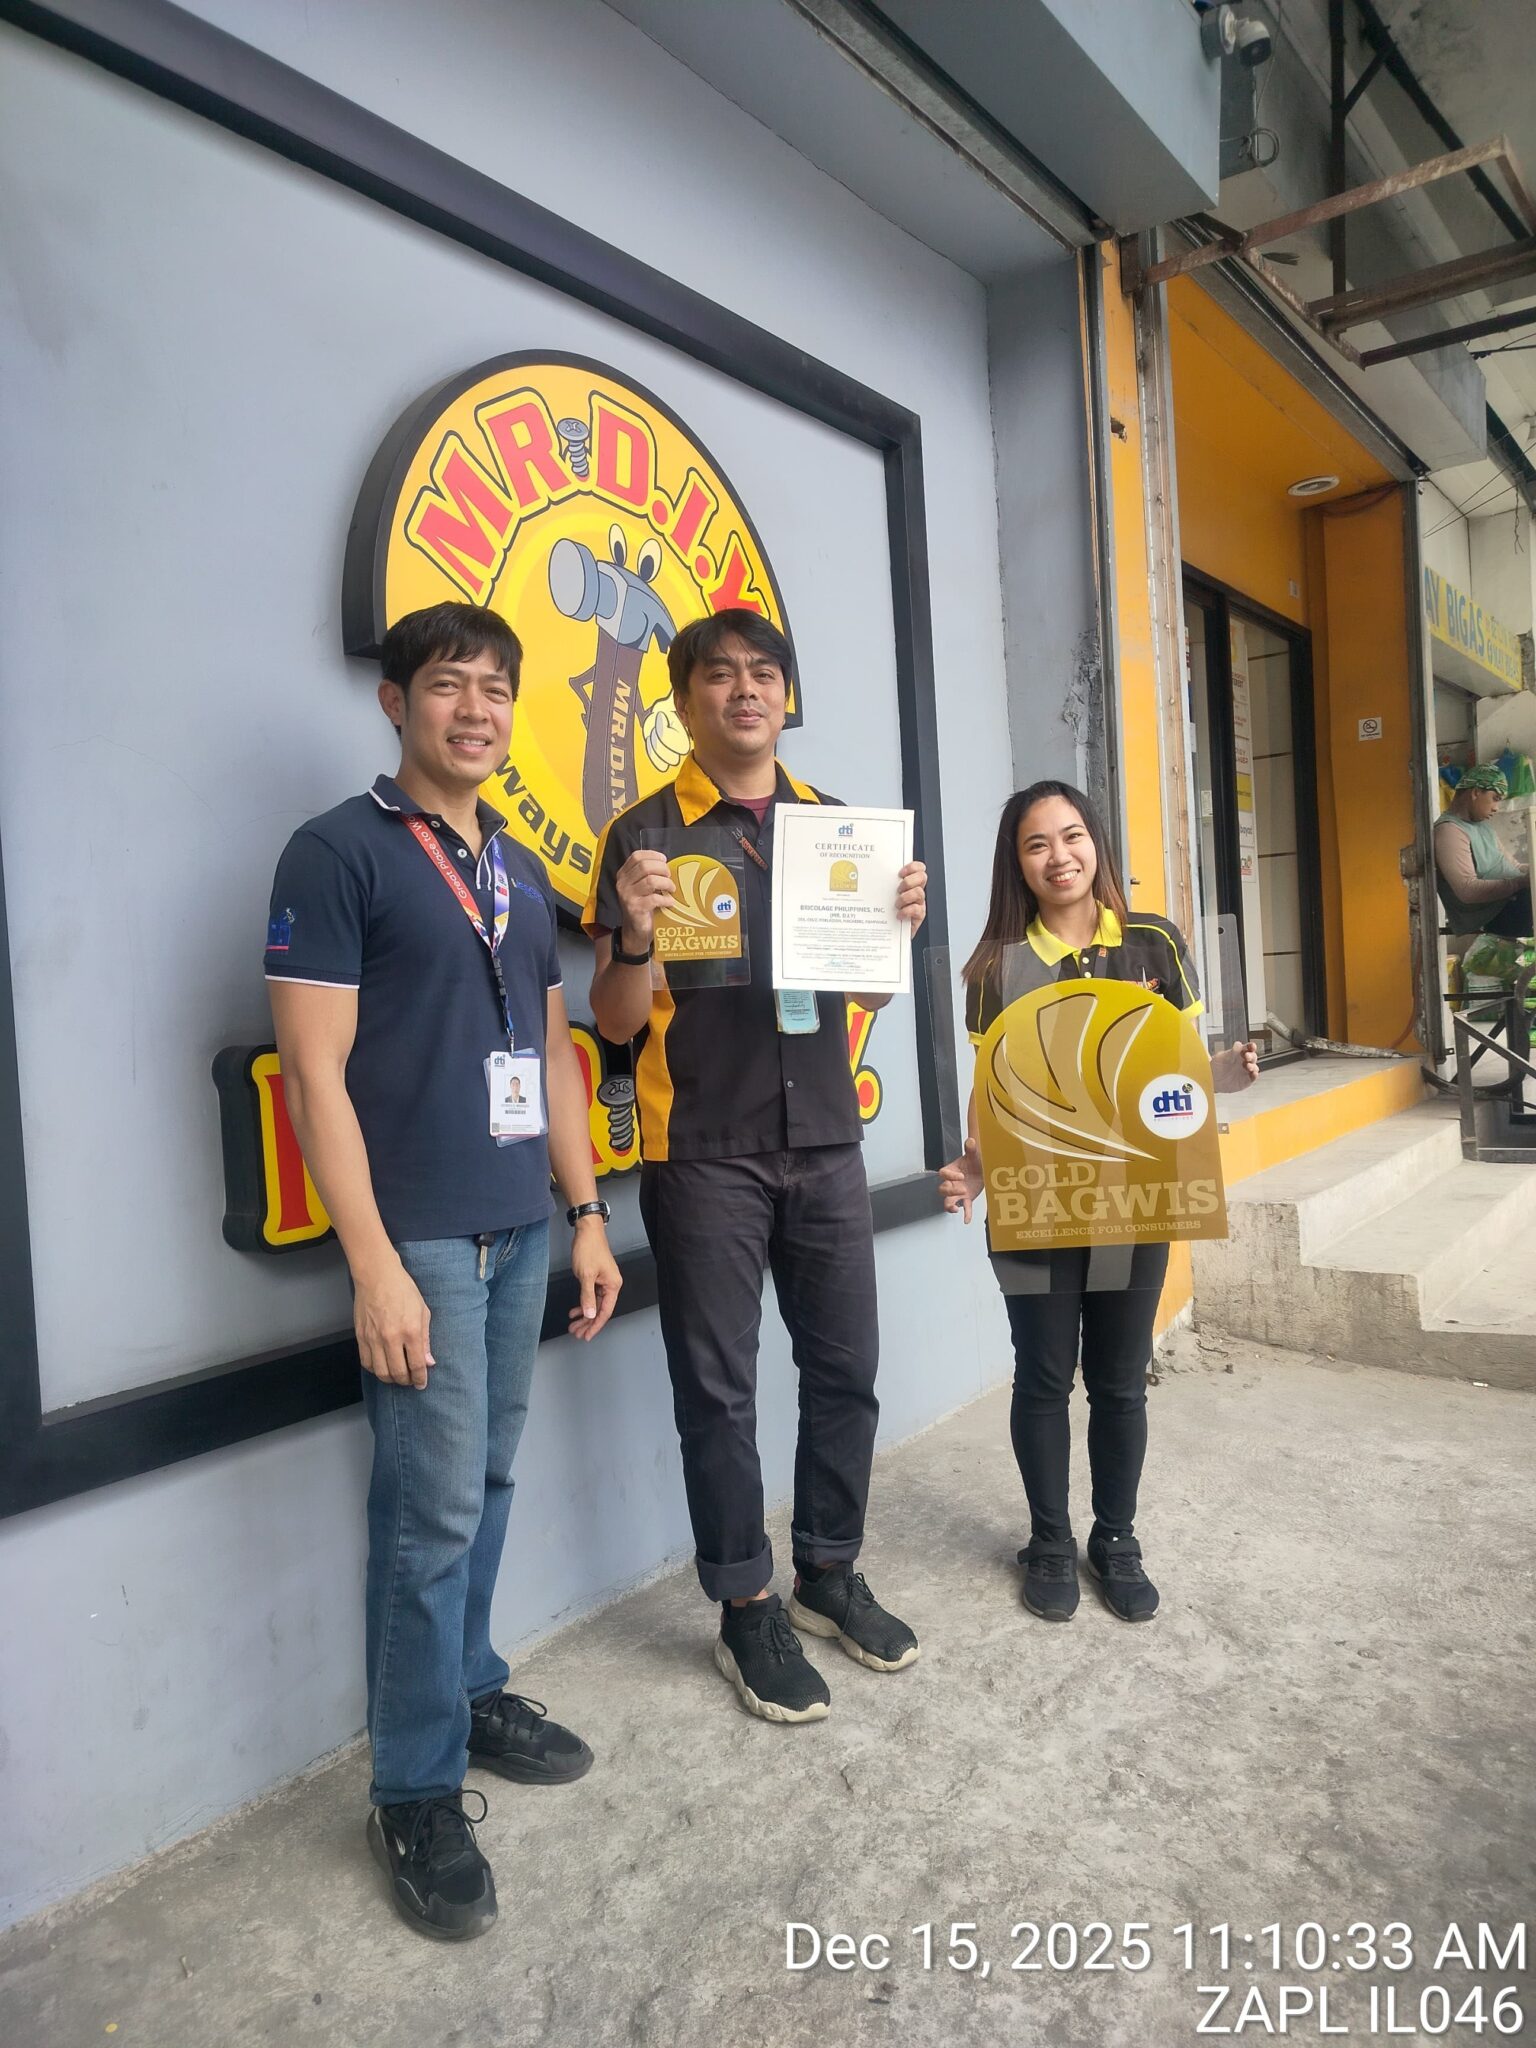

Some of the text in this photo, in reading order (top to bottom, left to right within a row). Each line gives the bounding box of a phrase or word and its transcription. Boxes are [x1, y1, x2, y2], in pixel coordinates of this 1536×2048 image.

[1446, 583, 1485, 657] BIGAS
[495, 754, 592, 874] ways
[422, 831, 432, 842] to
[838, 823, 854, 835] dti
[429, 840, 449, 870] Place
[815, 843, 875, 851] CERTIFICATE
[446, 871, 467, 899] Great
[717, 900, 732, 911] dti
[656, 926, 695, 937] GOLD
[657, 935, 738, 951] BAGWIS
[1152, 1083, 1193, 1113] dti
[990, 1161, 1096, 1191] GOLD
[994, 1179, 1219, 1226] BAGWIS
[1016, 1220, 1202, 1239] EXCELLENCE FOR CONSUMERS
